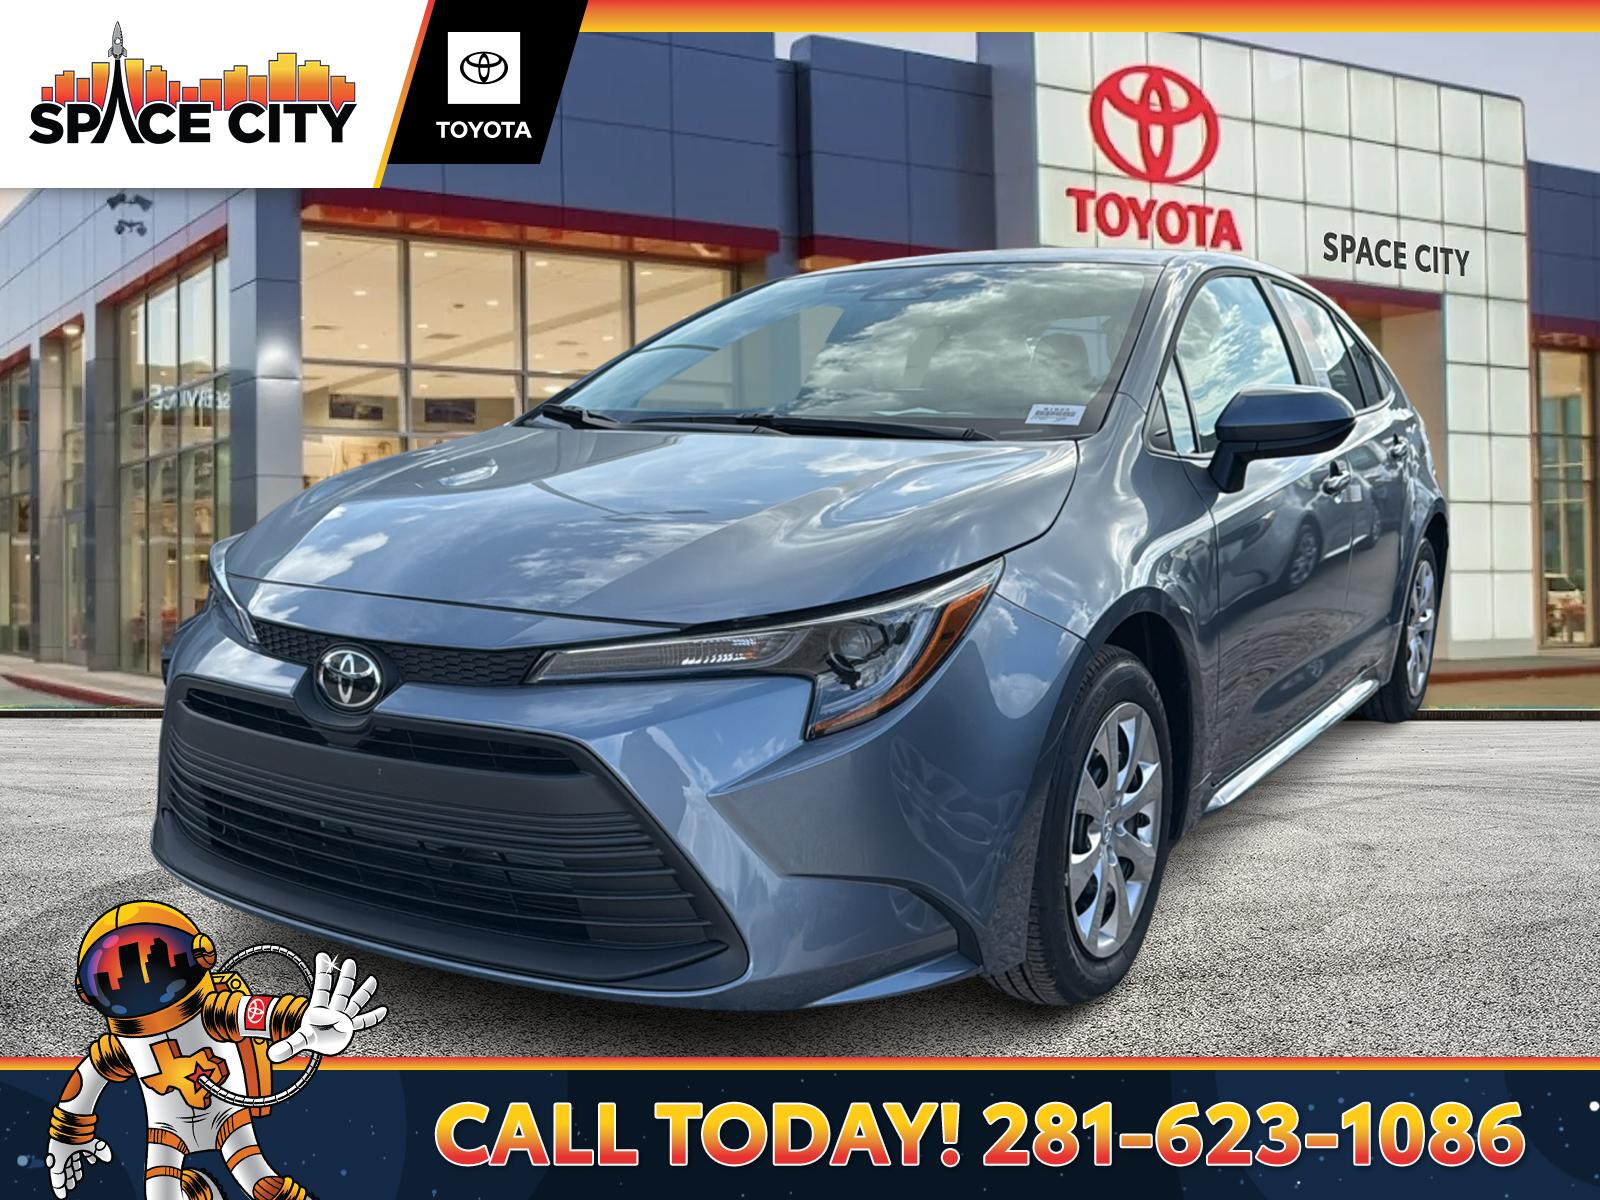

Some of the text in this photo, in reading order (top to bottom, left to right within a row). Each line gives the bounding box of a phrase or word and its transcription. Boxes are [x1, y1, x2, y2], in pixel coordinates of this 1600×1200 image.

[1067, 188, 1243, 250] TOYOTA
[1323, 232, 1470, 277] SPACE CITY
